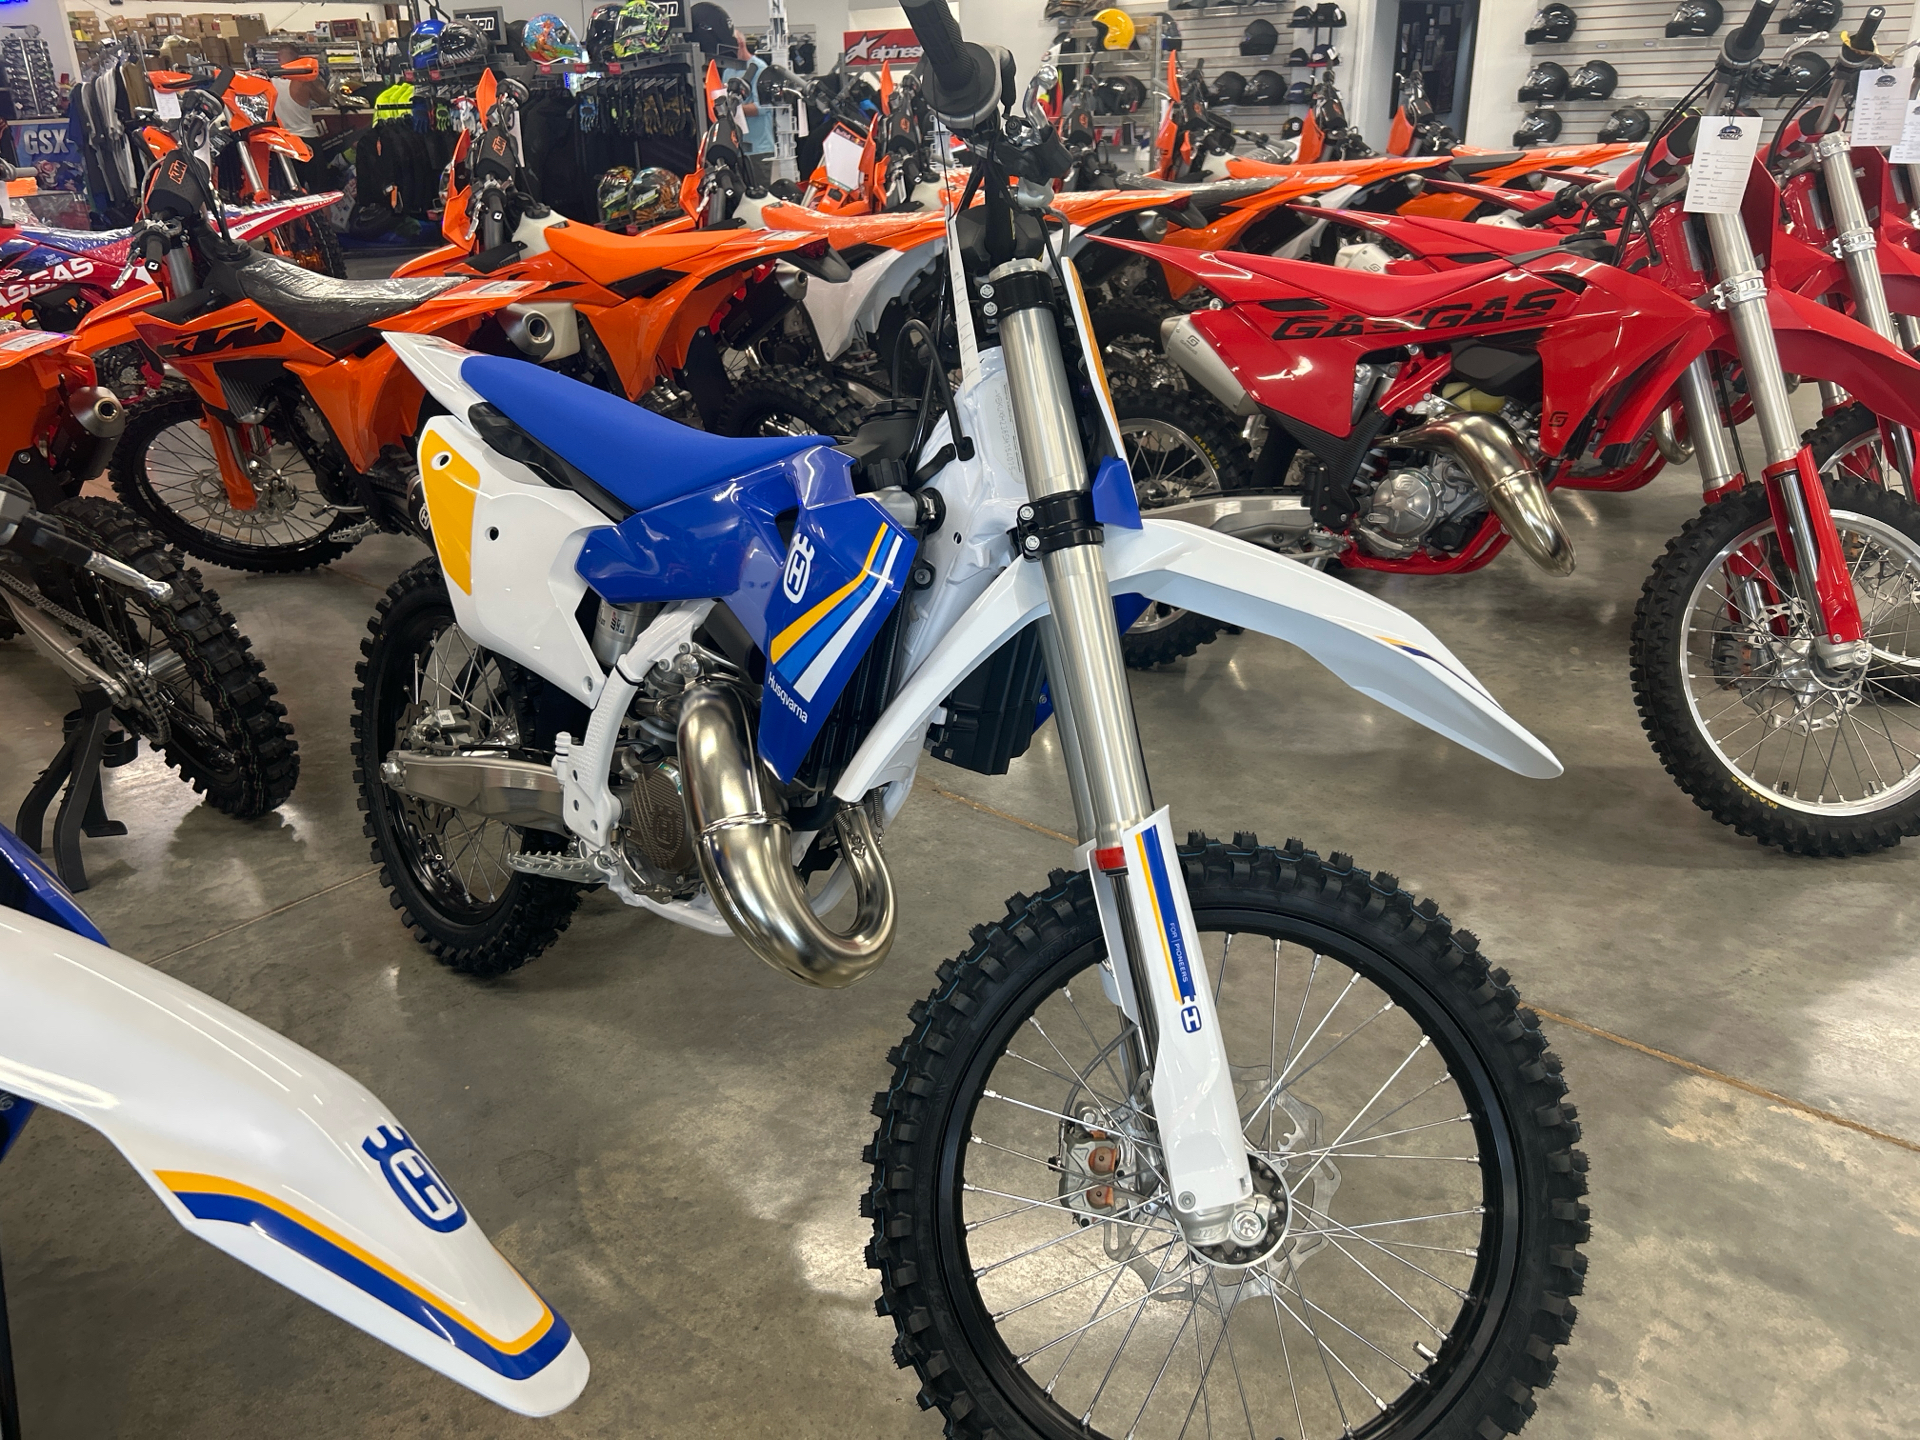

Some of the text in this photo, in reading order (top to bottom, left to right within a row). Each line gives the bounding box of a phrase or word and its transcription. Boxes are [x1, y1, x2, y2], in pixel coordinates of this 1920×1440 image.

[168, 160, 188, 185] KTM
[1272, 288, 1566, 341] GASGAS
[157, 317, 286, 357] KTM
[1193, 435, 1220, 470] MAXXIS
[768, 671, 809, 724] Husqvarna
[1731, 775, 1778, 810] MAXXIS
[1169, 922, 1189, 984] FOR PIONEERS
